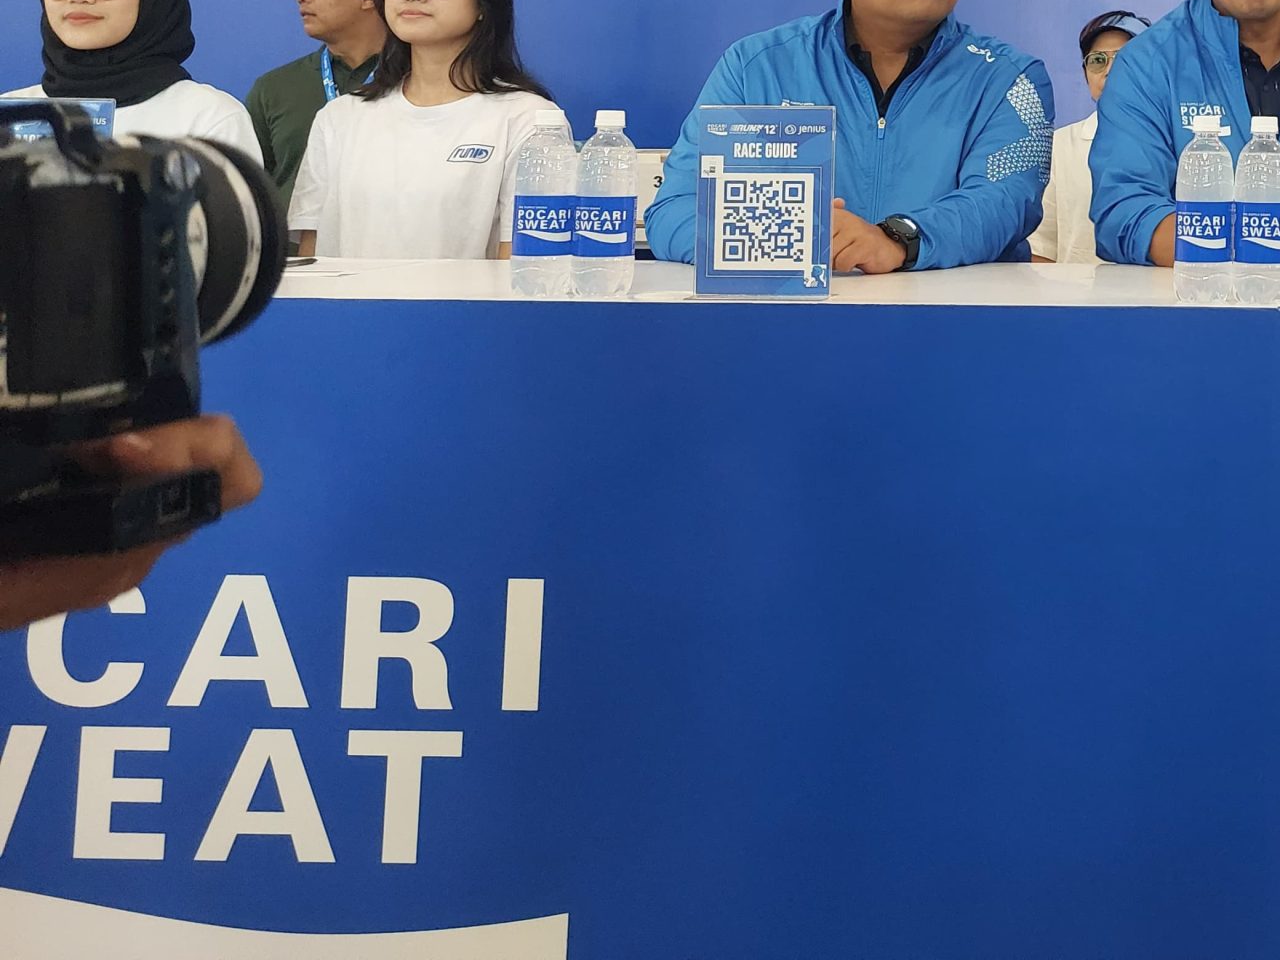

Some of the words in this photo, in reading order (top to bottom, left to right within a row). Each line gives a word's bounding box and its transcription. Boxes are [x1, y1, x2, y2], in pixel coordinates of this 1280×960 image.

[734, 143, 762, 158] RACE
[765, 143, 798, 158] GUIDE
[517, 209, 571, 220] POCARI
[575, 210, 627, 221] POCARI
[517, 219, 567, 230] SWEAT
[575, 220, 622, 231] SWEAT
[1177, 215, 1226, 226] POCARI
[1177, 226, 1221, 236] SWEAT
[26, 574, 545, 712] CARI
[0, 724, 464, 865] EAT
